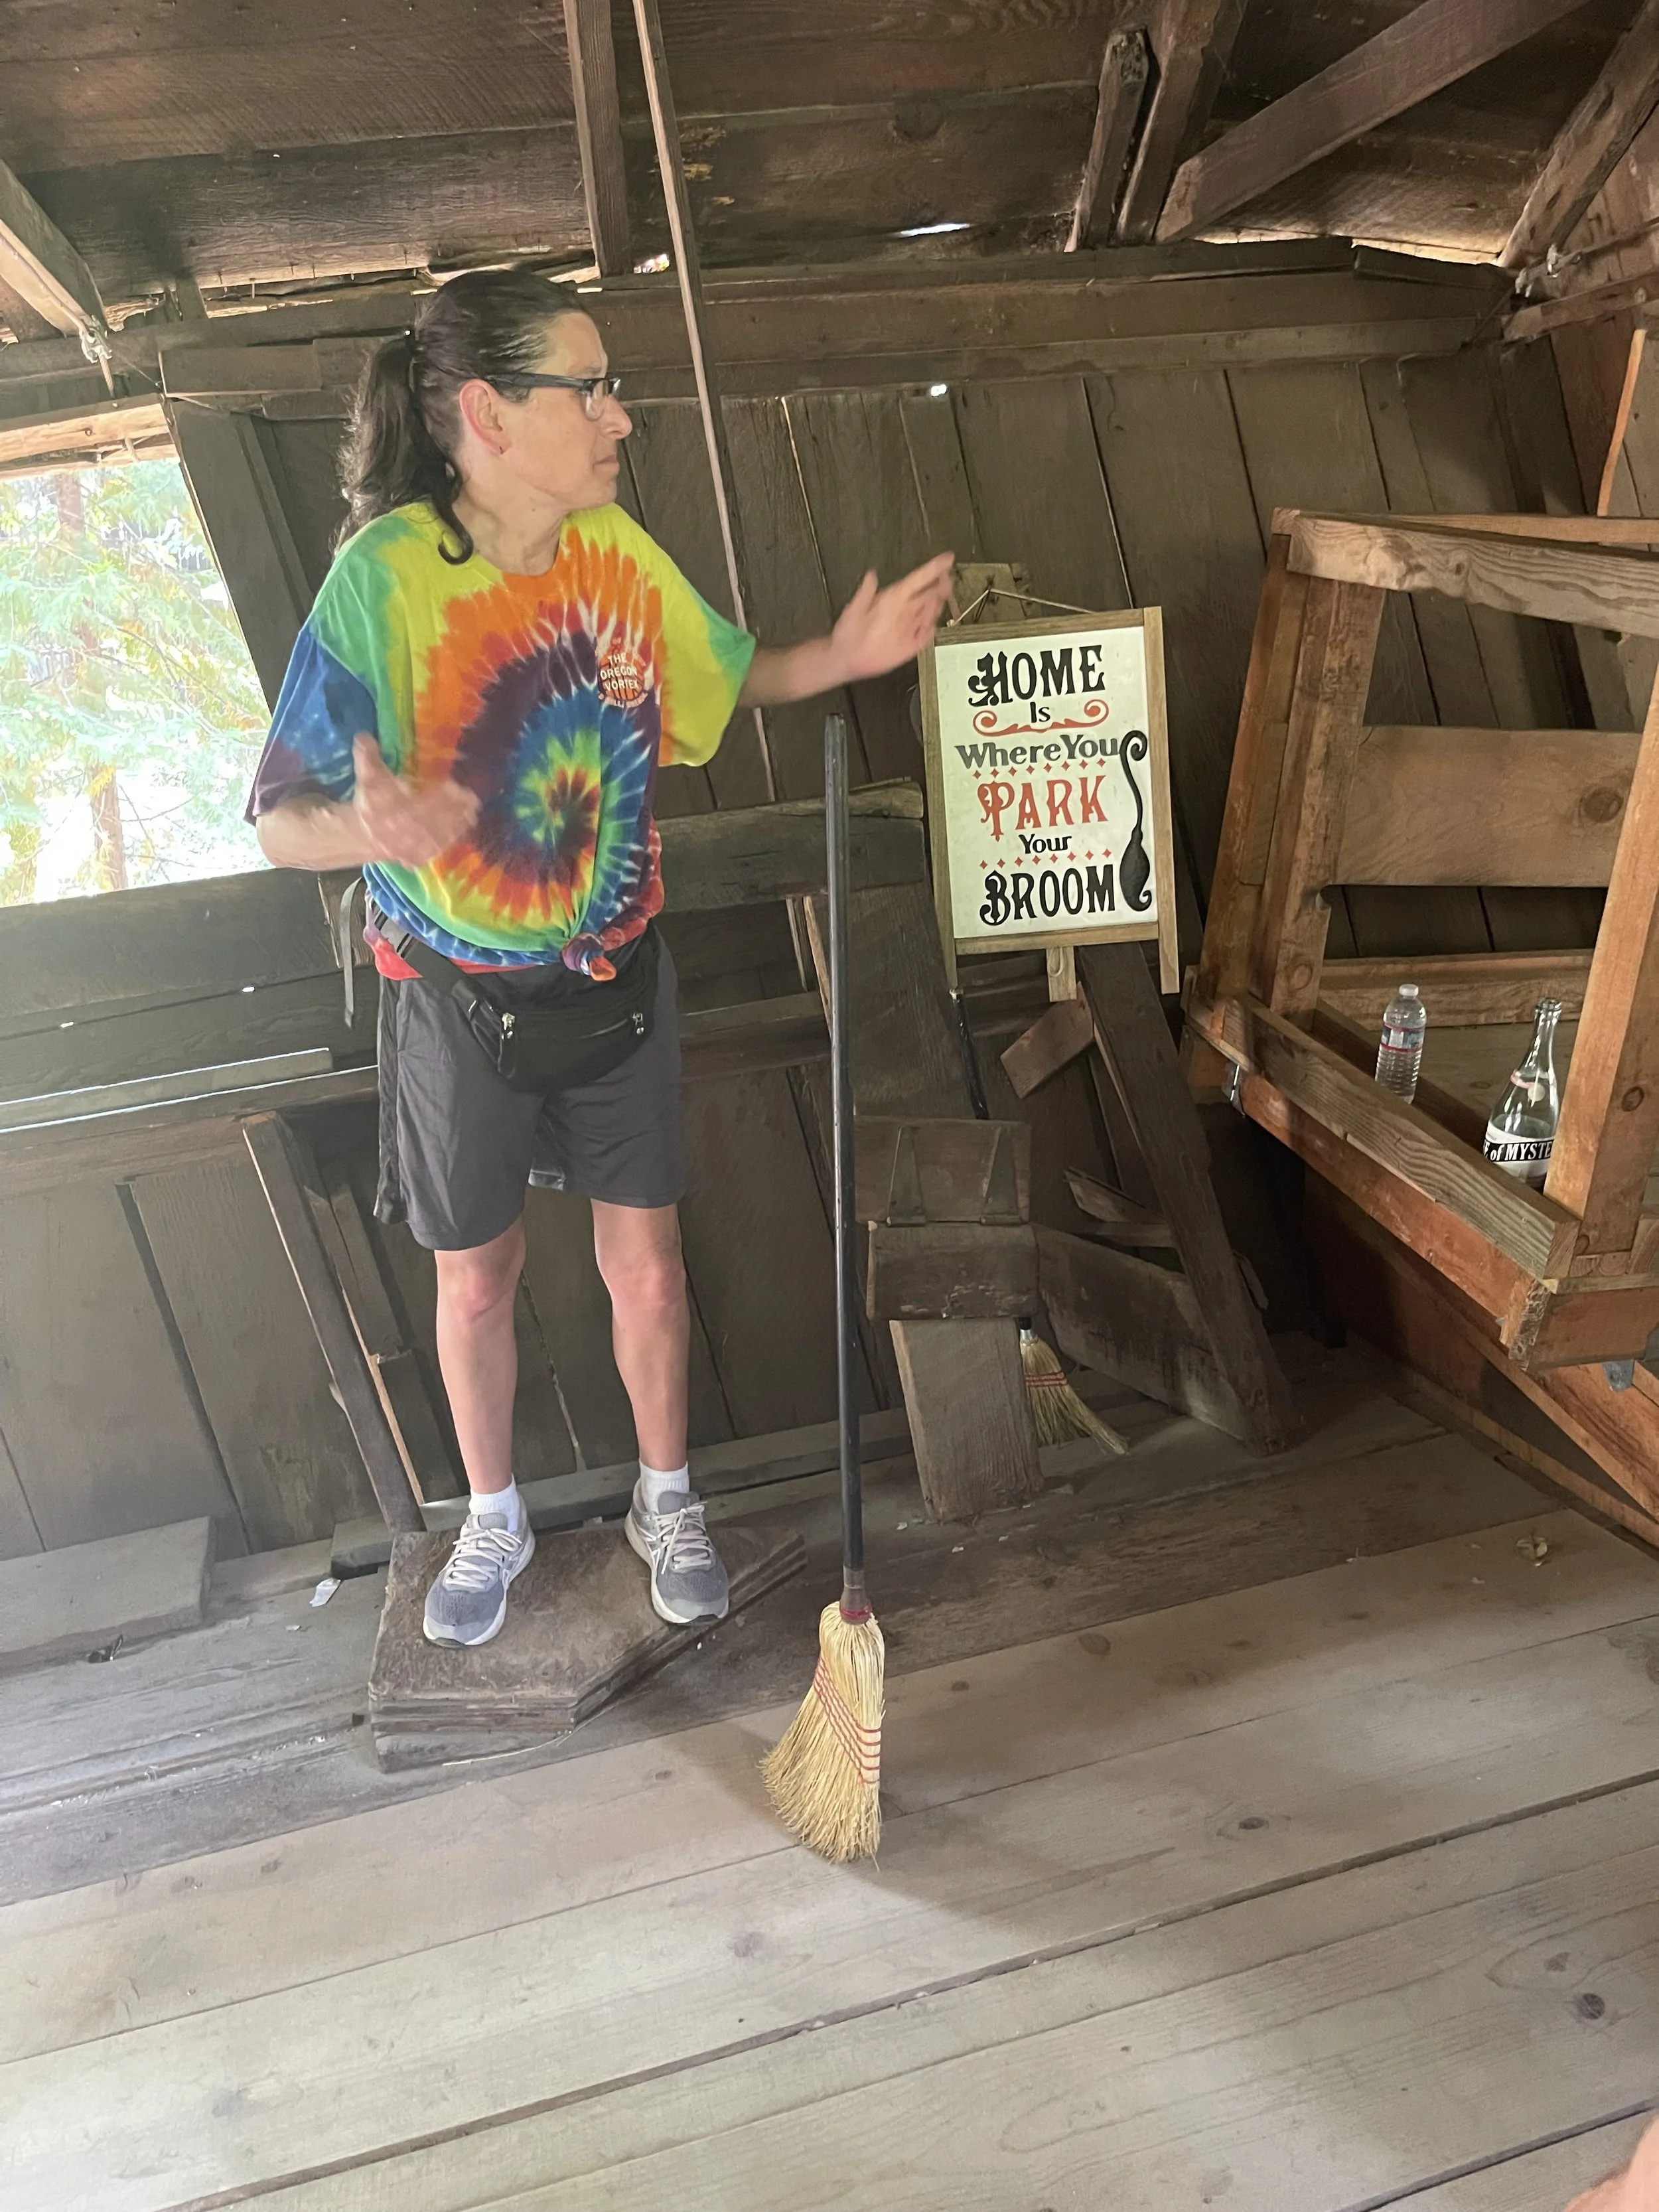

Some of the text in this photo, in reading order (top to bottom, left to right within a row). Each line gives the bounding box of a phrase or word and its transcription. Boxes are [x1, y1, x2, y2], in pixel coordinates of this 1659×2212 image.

[608, 652, 627, 666] THE
[600, 666, 638, 680] OREGON
[968, 644, 1106, 707] HOME
[605, 679, 639, 691] VORTEX
[1029, 701, 1051, 723] Is
[977, 774, 1108, 842] PARK
[1019, 834, 1072, 854] Your
[979, 863, 1116, 926] BROOM
[1490, 1144, 1505, 1161] of
